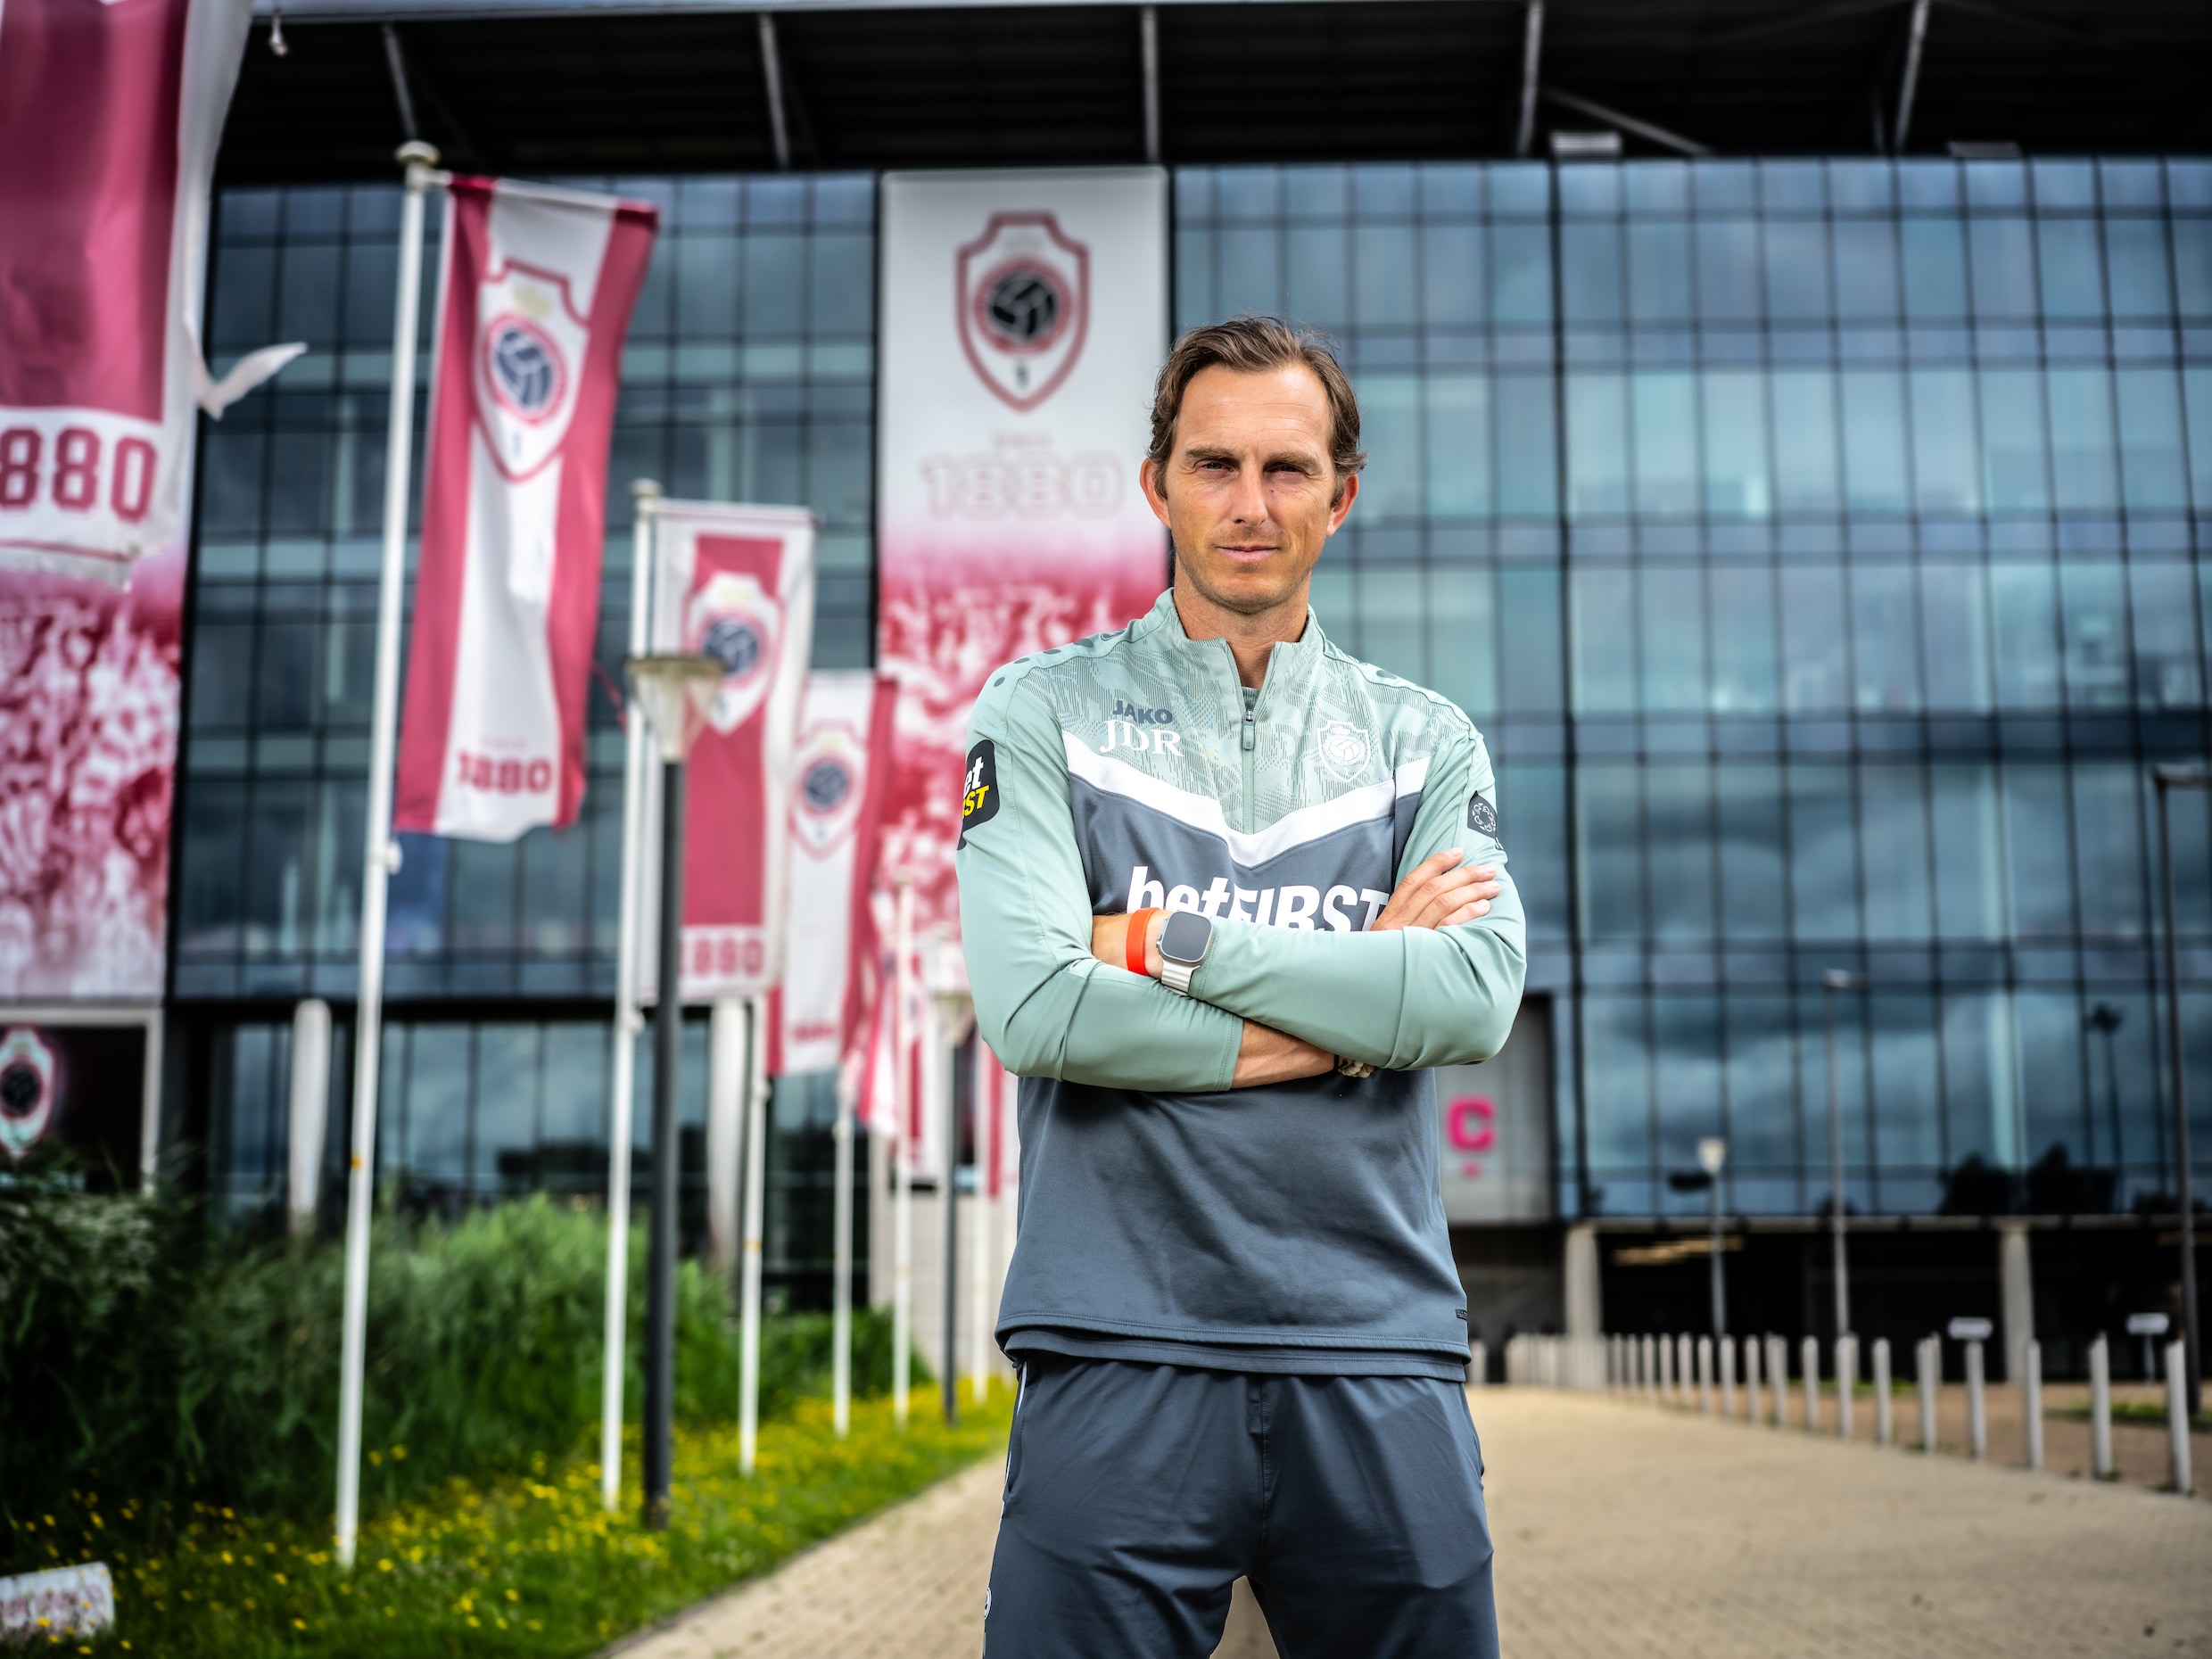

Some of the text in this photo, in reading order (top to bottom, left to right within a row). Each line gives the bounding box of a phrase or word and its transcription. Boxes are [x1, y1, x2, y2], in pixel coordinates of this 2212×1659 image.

[919, 450, 1126, 520] 1880
[1112, 700, 1173, 724] JAKO
[1099, 719, 1184, 757] JDR
[458, 750, 552, 796] 1880
[962, 785, 989, 819] ST
[679, 937, 764, 978] 880
